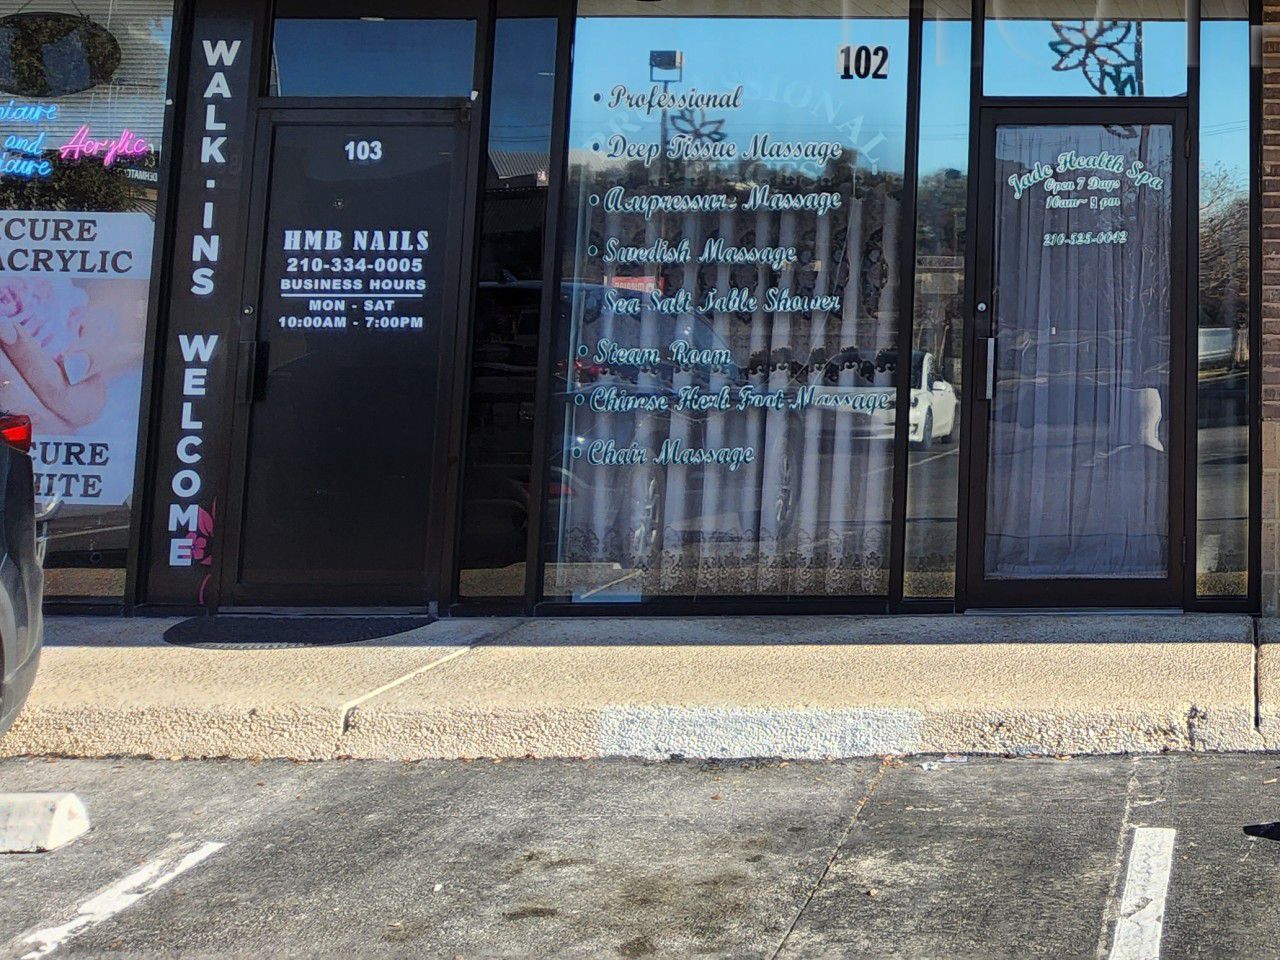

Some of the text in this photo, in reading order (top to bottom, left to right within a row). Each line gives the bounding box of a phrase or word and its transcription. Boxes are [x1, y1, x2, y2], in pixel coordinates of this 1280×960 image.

[841, 44, 890, 80] 102
[606, 83, 744, 116] Professional
[5, 123, 148, 167] and Acrylic
[344, 140, 383, 161] 103
[607, 133, 843, 168] Deep Tissue Massage
[1007, 150, 1164, 200] Jade Health Spa
[1044, 176, 1121, 194] Open 7 Days
[741, 184, 842, 216] Massage
[1089, 195, 1098, 209] 9
[1099, 196, 1121, 211] pm
[0, 218, 97, 241] CURE
[283, 229, 430, 251] HMB NAILS
[286, 257, 423, 272] 210-334-0005
[602, 237, 798, 271] Swedish Massage
[280, 278, 427, 290] BUSINESS HOURS
[308, 299, 346, 311] MON
[364, 299, 395, 311] SAT
[603, 286, 841, 314] Sea Salt Table Shower
[278, 316, 347, 328] 10:00AM
[365, 316, 424, 328] 7:00PM
[592, 338, 732, 366] Steam Room
[673, 385, 730, 414] Herb
[31, 442, 109, 466] URE
[168, 334, 218, 567] WELCOME
[586, 438, 755, 472] Chair Massage
